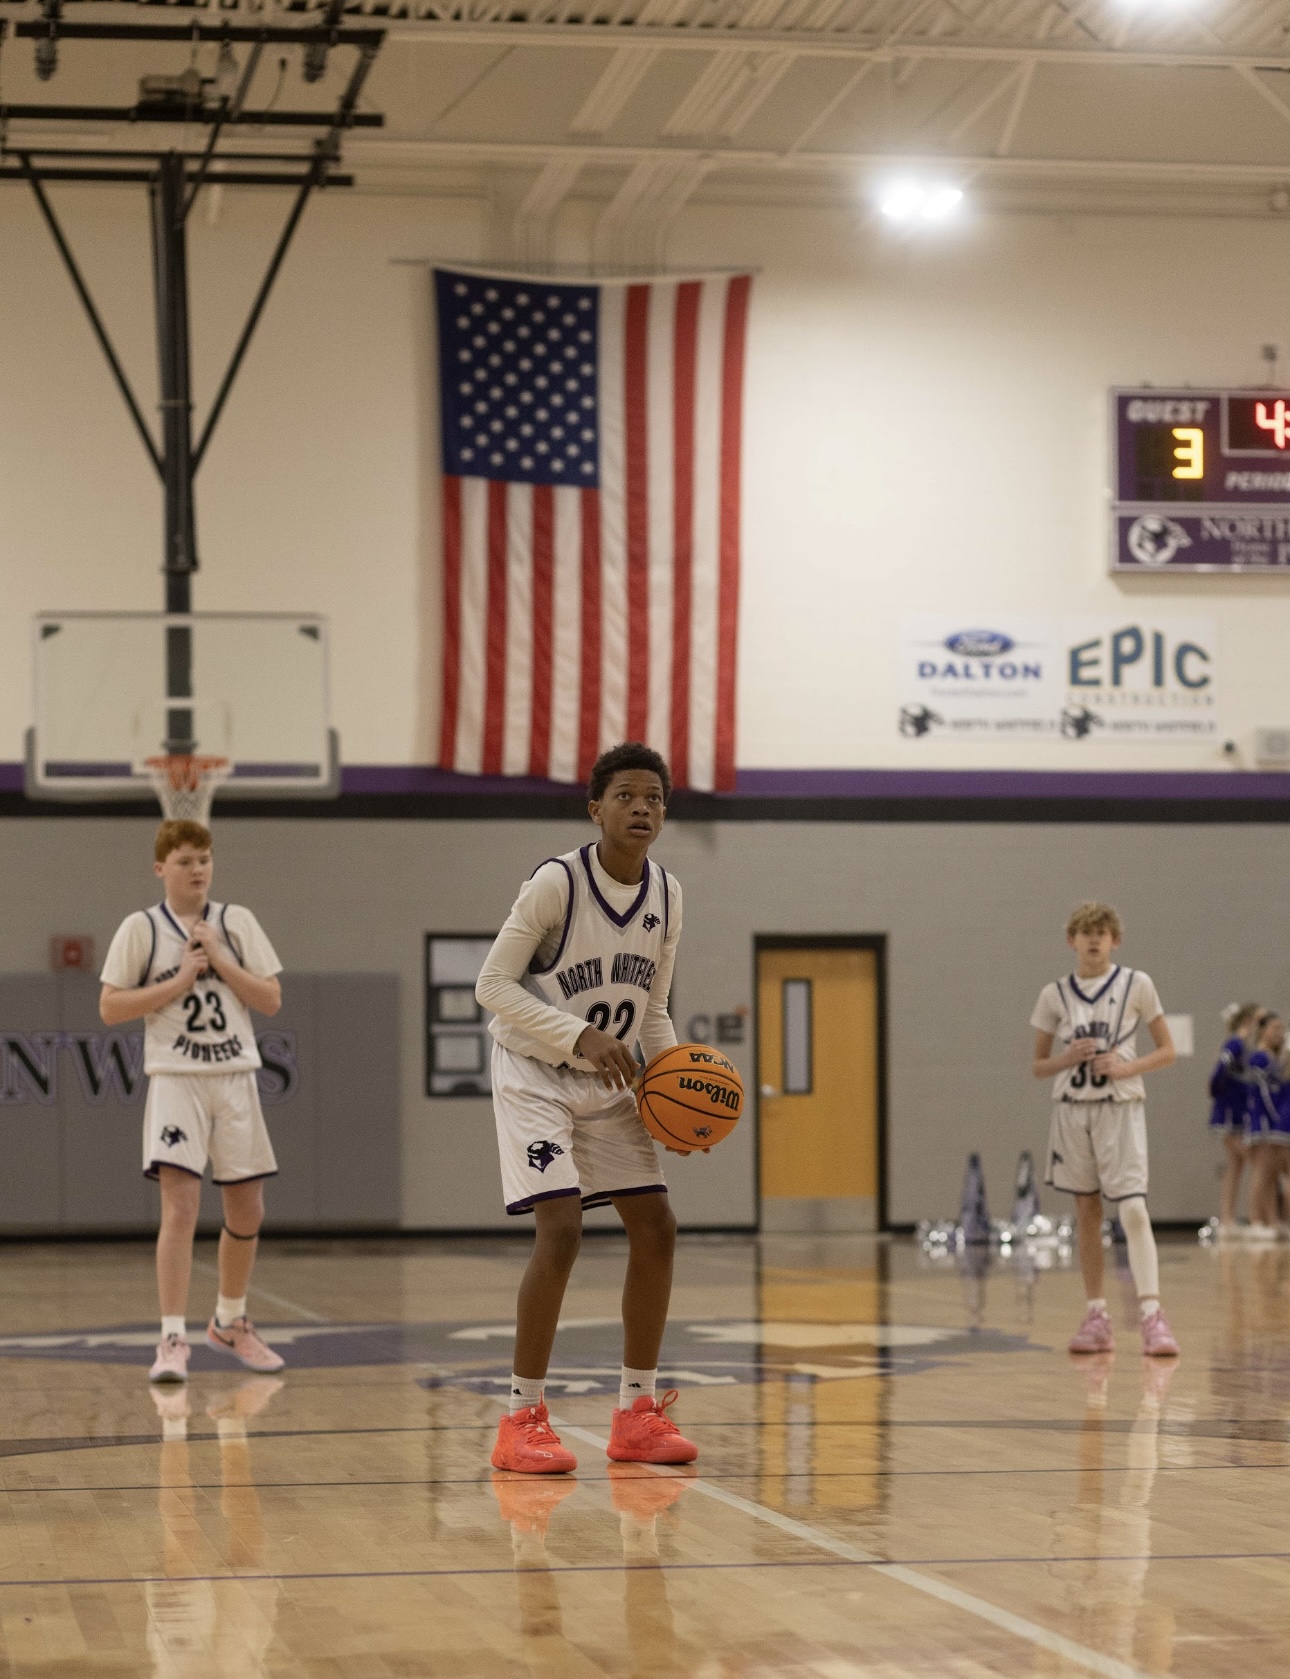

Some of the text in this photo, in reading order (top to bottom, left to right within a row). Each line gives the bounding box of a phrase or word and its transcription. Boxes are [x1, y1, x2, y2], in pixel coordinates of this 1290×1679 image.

[1172, 428, 1204, 479] 3
[917, 660, 1042, 680] DALTON
[1069, 625, 1210, 689] EPIC
[556, 957, 603, 1000] NORTH
[183, 991, 226, 1033] 23
[580, 999, 636, 1058] 22
[689, 1053, 734, 1073] NCAA
[679, 1077, 740, 1111] Wilson
